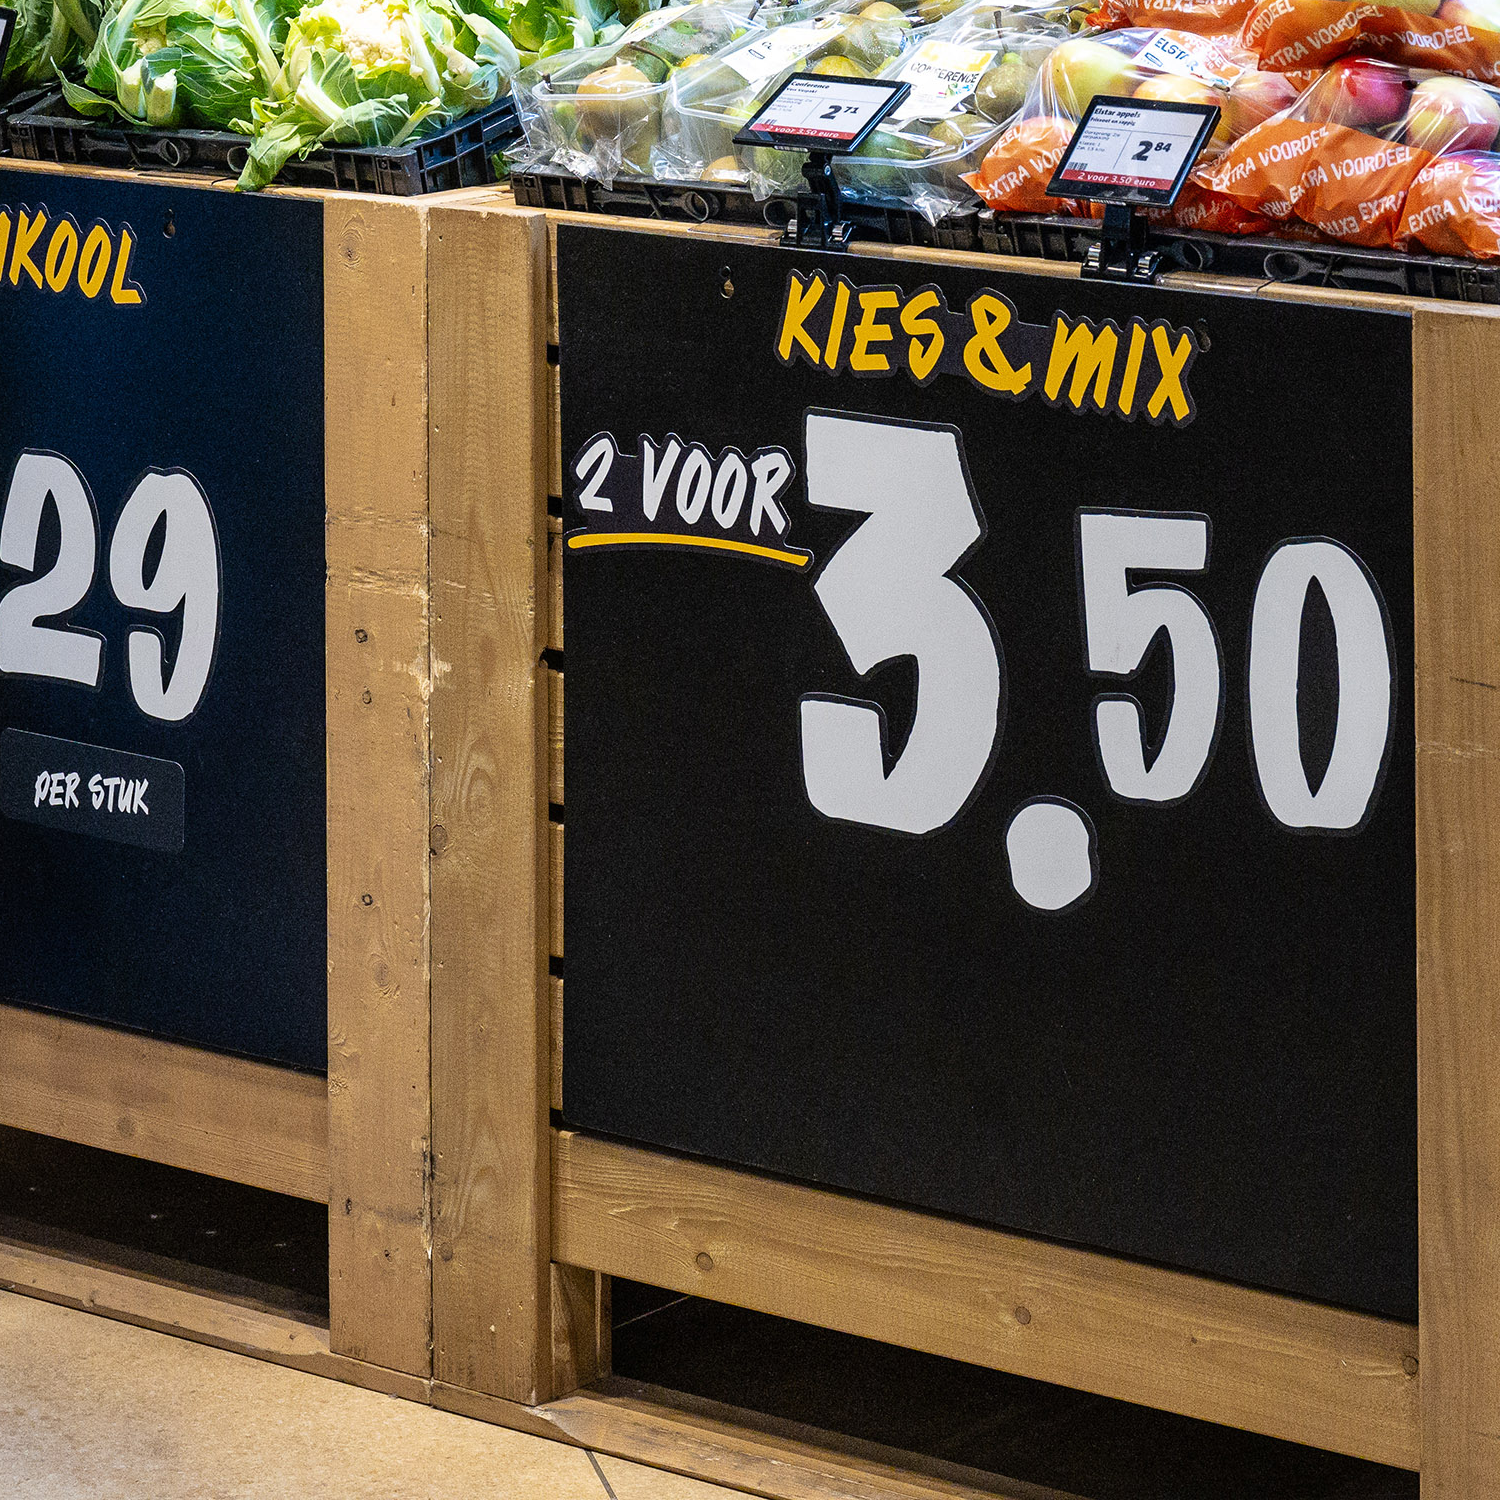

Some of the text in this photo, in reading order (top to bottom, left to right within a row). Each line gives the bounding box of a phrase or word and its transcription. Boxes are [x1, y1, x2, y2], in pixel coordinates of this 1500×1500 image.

[1307, 4, 1384, 50] VOORDEEL
[1393, 24, 1474, 50] VOORDEEL
[791, 81, 830, 90] Conference
[1094, 107, 1141, 119] Elstar appels
[797, 128, 817, 136] 3.50
[1077, 172, 1156, 187] 2 voor 3.50 euro
[1330, 146, 1413, 181] VOORDEEL
[1408, 199, 1455, 232] EXTRA
[777, 279, 1193, 422] KIES & MIX
[576, 437, 791, 535] 2 VOOR
[800, 414, 1392, 910] 3.50
[33, 770, 149, 815] PER STUK
